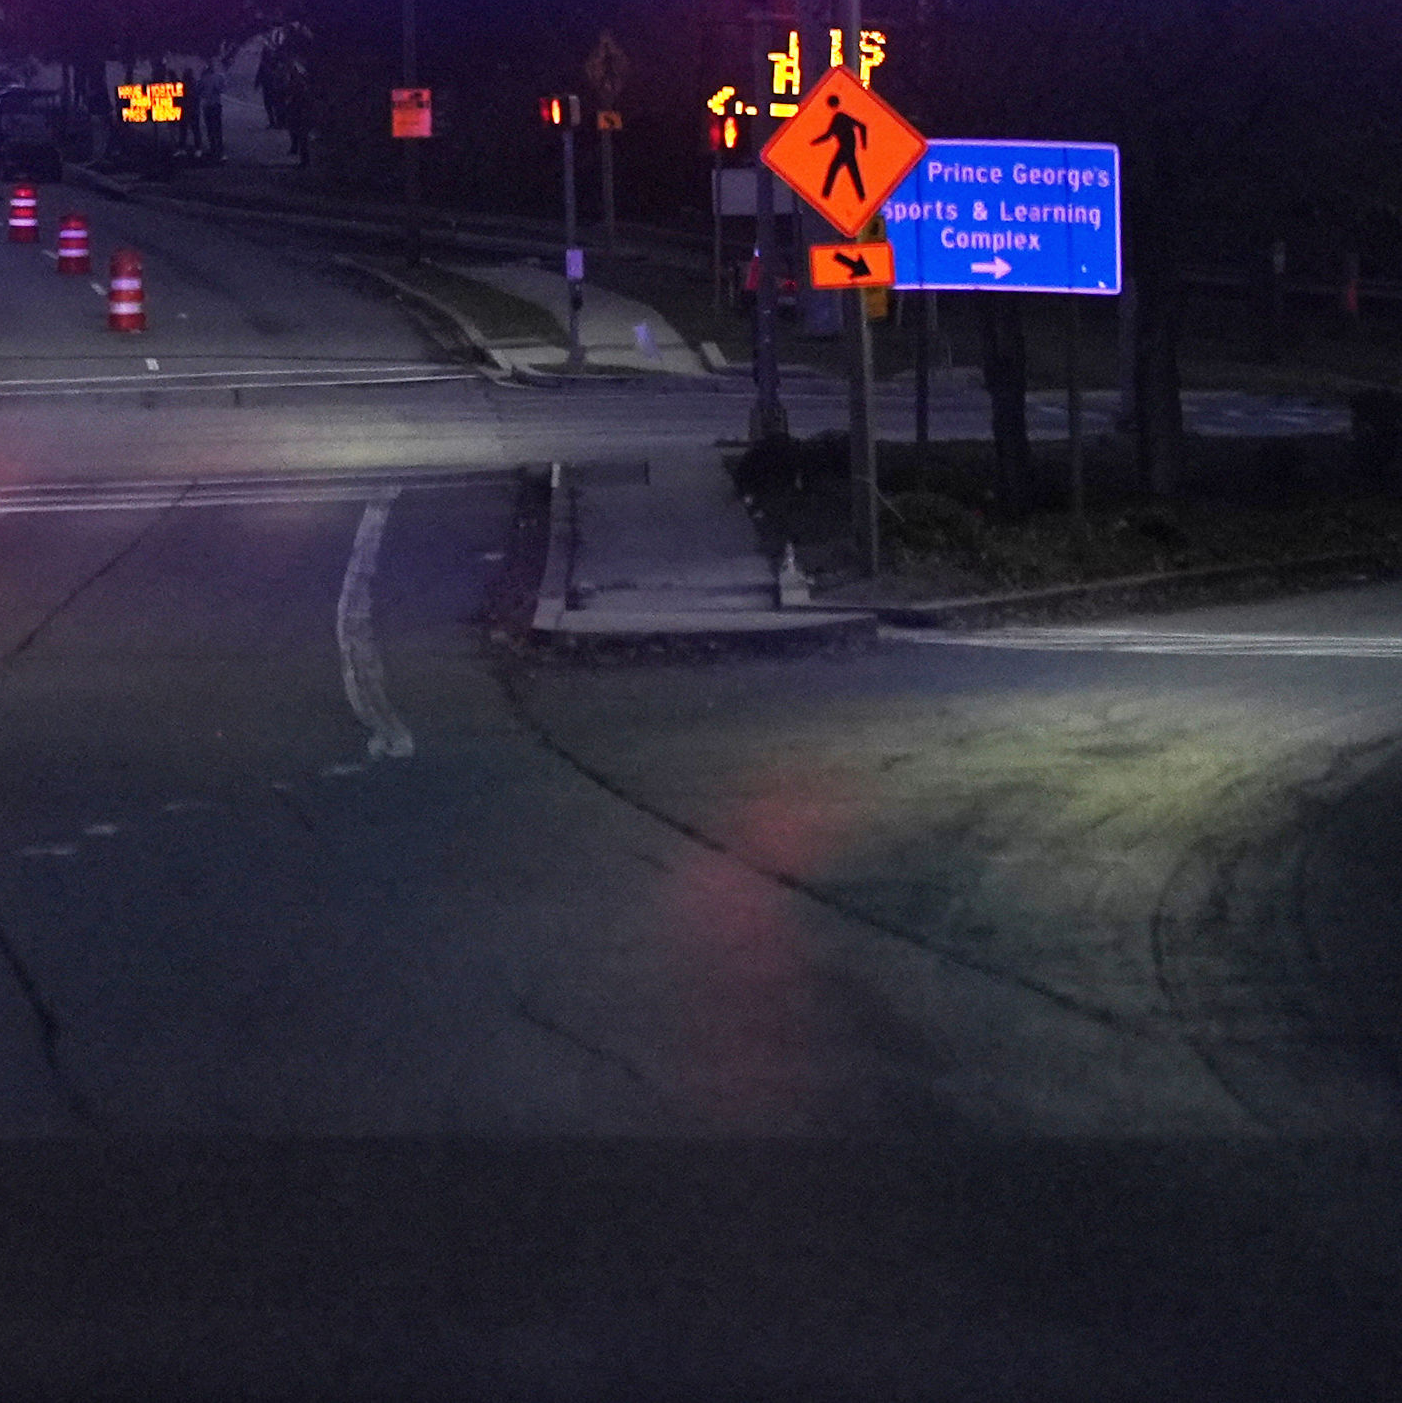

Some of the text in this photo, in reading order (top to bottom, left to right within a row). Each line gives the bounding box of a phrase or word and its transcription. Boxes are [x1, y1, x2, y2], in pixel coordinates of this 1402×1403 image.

[928, 161, 1111, 192] Prince George's
[973, 200, 988, 222] &
[1000, 200, 1102, 231] Learning
[940, 227, 1042, 254] Complex
